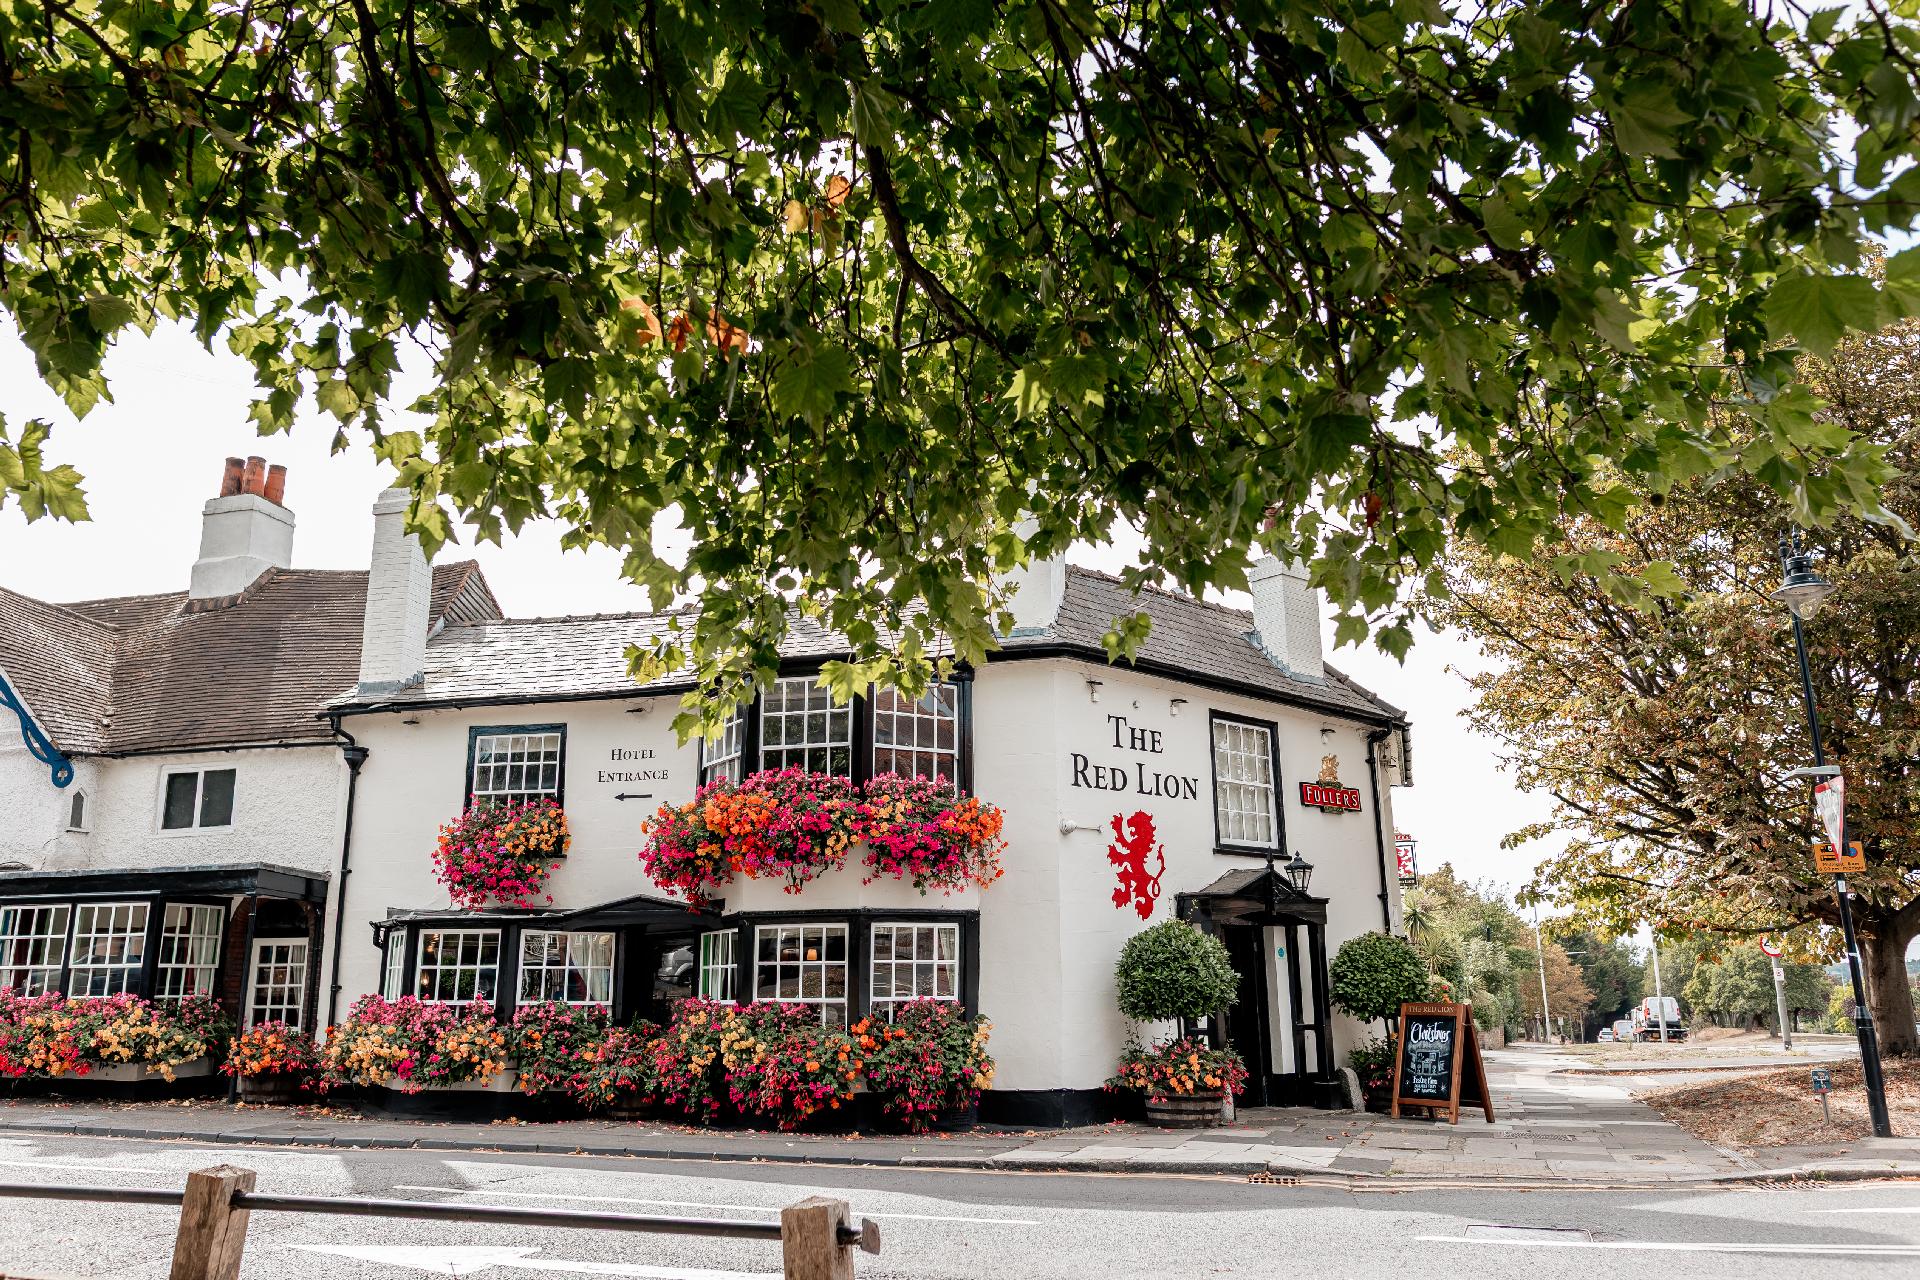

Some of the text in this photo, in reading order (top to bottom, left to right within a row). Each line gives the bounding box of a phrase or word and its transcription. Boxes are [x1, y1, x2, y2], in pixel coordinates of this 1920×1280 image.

[1107, 714, 1164, 754] THE
[611, 748, 657, 761] HOTEL
[597, 769, 669, 783] ENTRANCE
[1070, 752, 1199, 801] RED LION
[1306, 786, 1358, 807] FULLER'S
